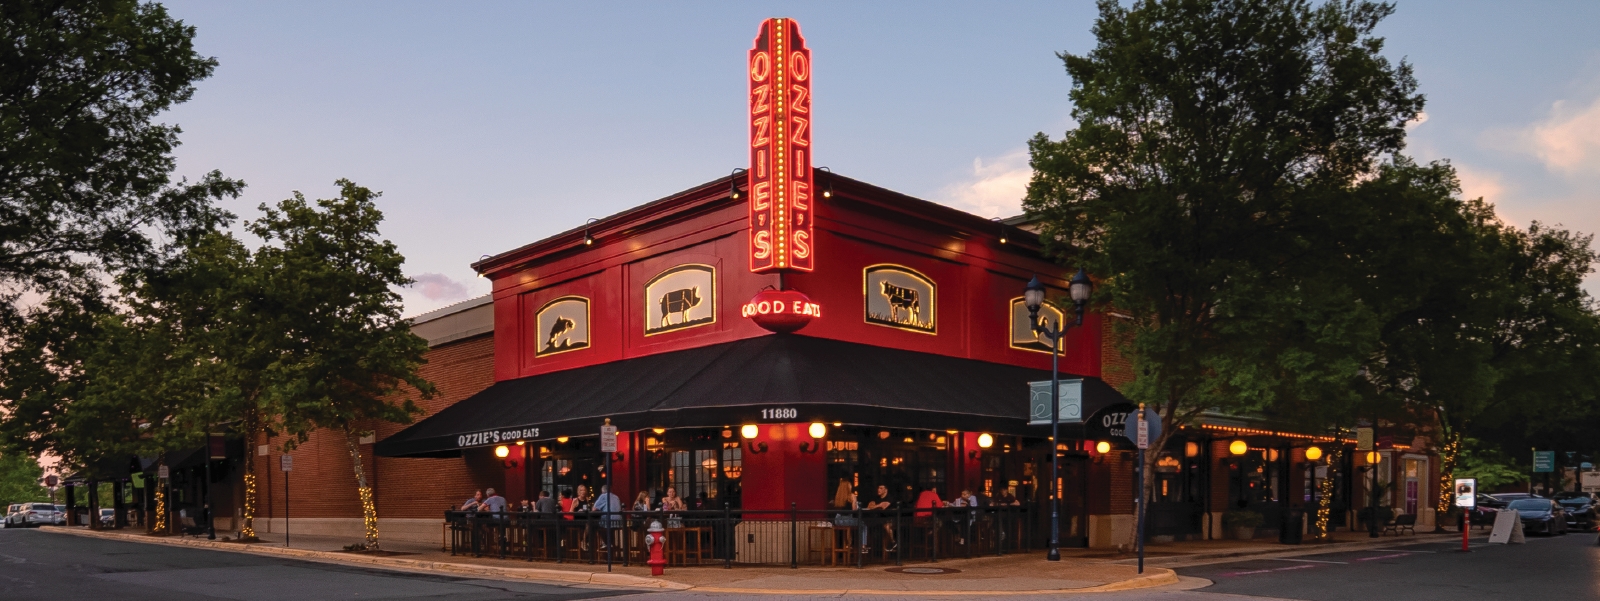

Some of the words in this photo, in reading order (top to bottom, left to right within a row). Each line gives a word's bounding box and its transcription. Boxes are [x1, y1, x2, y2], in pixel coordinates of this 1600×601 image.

[751, 51, 771, 260] OZZIE'S
[790, 51, 810, 260] OZZIE'S
[742, 300, 785, 317] GOOD
[793, 300, 820, 317] EATS
[761, 408, 797, 419] 11880
[1103, 412, 1132, 428] OZZ
[458, 430, 500, 447] OZZIE'S
[501, 429, 522, 440] GOOD
[522, 427, 540, 439] EATS
